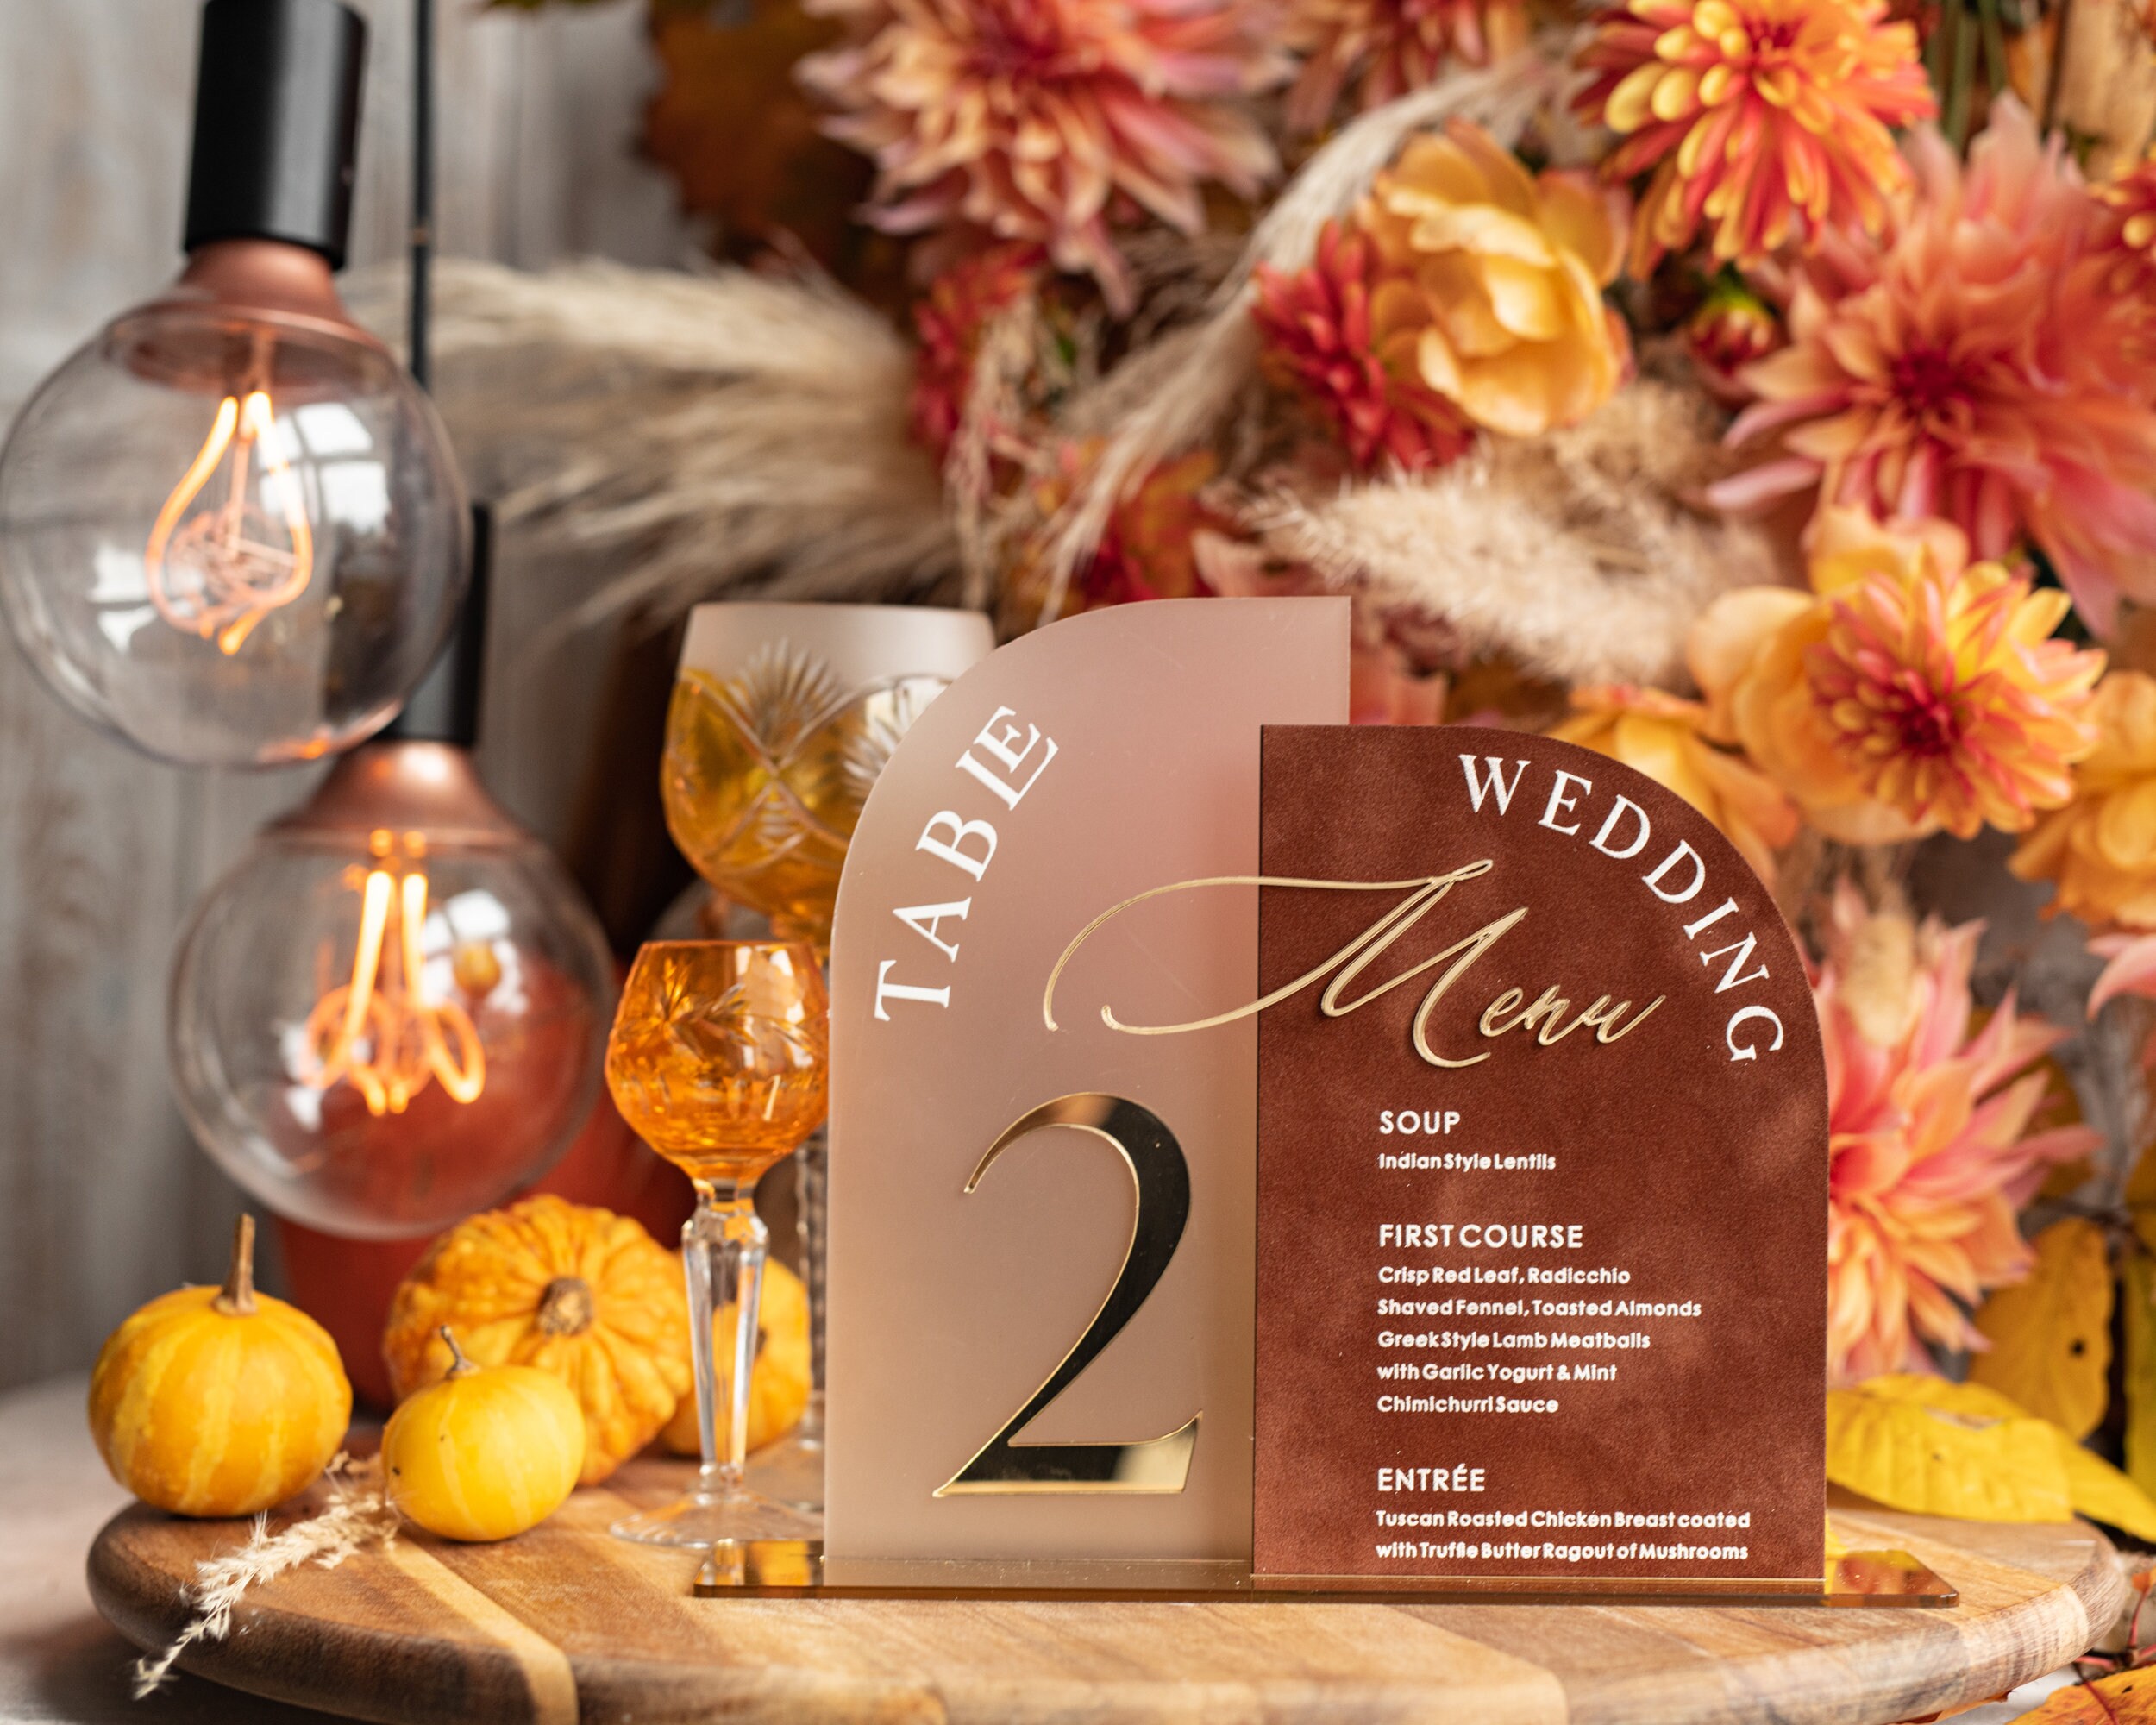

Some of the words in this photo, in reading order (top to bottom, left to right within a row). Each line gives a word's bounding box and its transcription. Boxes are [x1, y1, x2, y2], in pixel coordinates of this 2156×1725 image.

[874, 706, 1059, 1022] TABLE
[1457, 753, 1785, 1063] WEDDING
[1044, 858, 1667, 1069] Menu
[1379, 1110, 1461, 1135] SOUP
[1378, 1152, 1442, 1170] Indian
[1443, 1152, 1492, 1173] Style
[1494, 1153, 1557, 1170] Lentils
[1379, 1223, 1455, 1248] FIRST
[1458, 1223, 1583, 1249] COURSE
[1377, 1265, 1430, 1287] Crisp
[1432, 1266, 1471, 1283] Red
[1473, 1266, 1526, 1285] Leaf,
[1527, 1266, 1631, 1284] Radicchio
[931, 1092, 1204, 1499] 2
[1377, 1298, 1453, 1316] Shaved
[1456, 1299, 1530, 1317] Fennel,
[1531, 1299, 1613, 1317] Toasted
[1614, 1299, 1702, 1317] Almonds
[1377, 1330, 1440, 1348] Greek
[1440, 1331, 1490, 1352] Style
[1492, 1331, 1548, 1349] Lamb
[1550, 1331, 1651, 1349] Meatballs
[1376, 1363, 1420, 1380] with
[1421, 1363, 1485, 1381] Garlic
[1486, 1364, 1554, 1384] Yogurt
[1556, 1364, 1571, 1381] &
[1572, 1364, 1618, 1381] Mint
[1376, 1395, 1494, 1413] Chimichurri
[1495, 1396, 1559, 1414] Sauce
[1377, 1463, 1486, 1492] ENTRÉE
[1376, 1509, 1445, 1527] Tuscan
[1447, 1510, 1528, 1527] Roasted
[1530, 1510, 1612, 1527] Chicken
[1614, 1511, 1676, 1528] Breast
[1677, 1511, 1751, 1528] coated
[1375, 1541, 1418, 1559] with
[1419, 1541, 1479, 1559] Truffle
[1481, 1541, 1542, 1559] Butter
[1542, 1542, 1615, 1563] Ragout
[1615, 1542, 1638, 1559] of
[1639, 1542, 1749, 1560] Mushrooms
